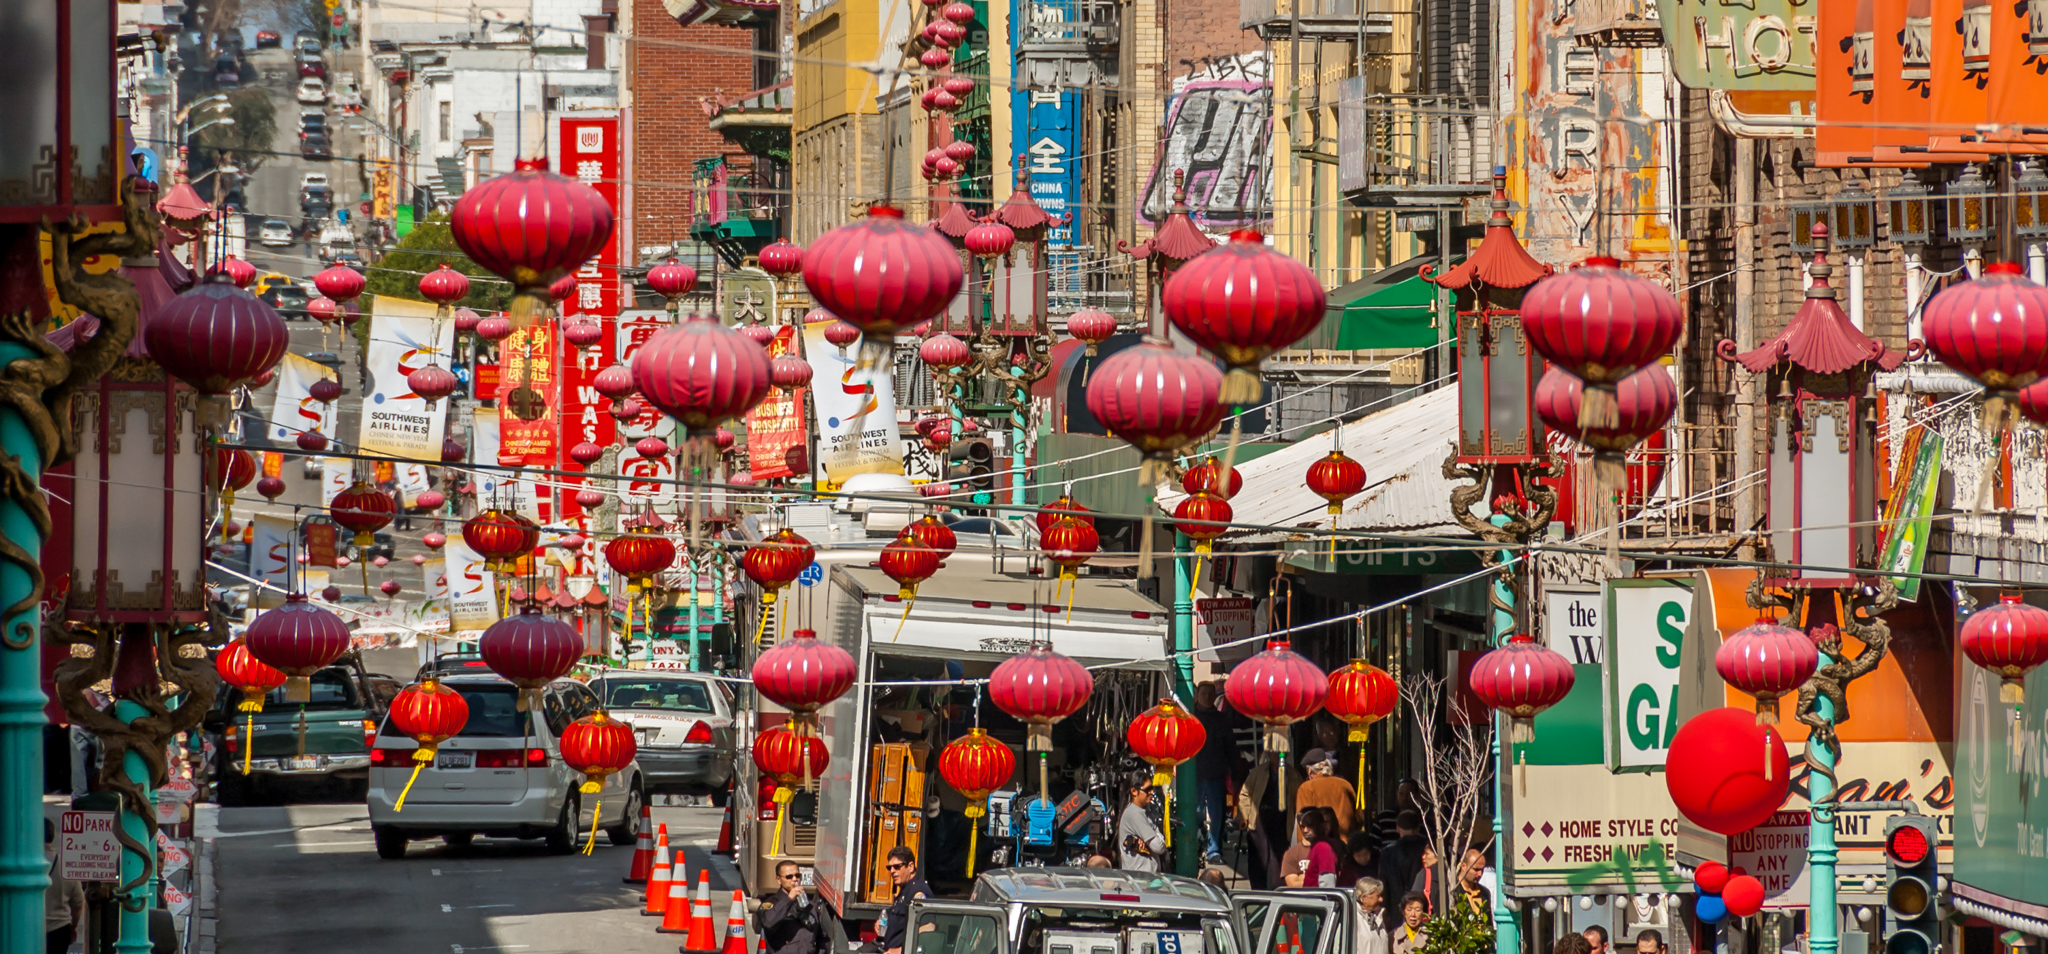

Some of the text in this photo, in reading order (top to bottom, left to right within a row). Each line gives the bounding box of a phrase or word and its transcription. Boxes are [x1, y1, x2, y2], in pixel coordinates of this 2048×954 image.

[1553, 0, 1599, 247] ERY
[1031, 183, 1063, 194] CHINA
[733, 284, 767, 322] 大
[371, 411, 431, 425] SOUTHWEST
[370, 421, 429, 434] AIRLINES
[1202, 601, 1246, 609] TOW-AWAY
[1568, 600, 1597, 627] the
[1214, 611, 1250, 622] STOPPING
[1214, 626, 1235, 636] ANY
[64, 814, 82, 832] NO
[1559, 820, 1602, 839] HOME
[1608, 819, 1654, 837] STYLE
[1733, 829, 1809, 851] NO STOPPING
[1564, 844, 1612, 862] FRESH
[1757, 855, 1788, 871] ANY
[1755, 874, 1791, 891] TIME
